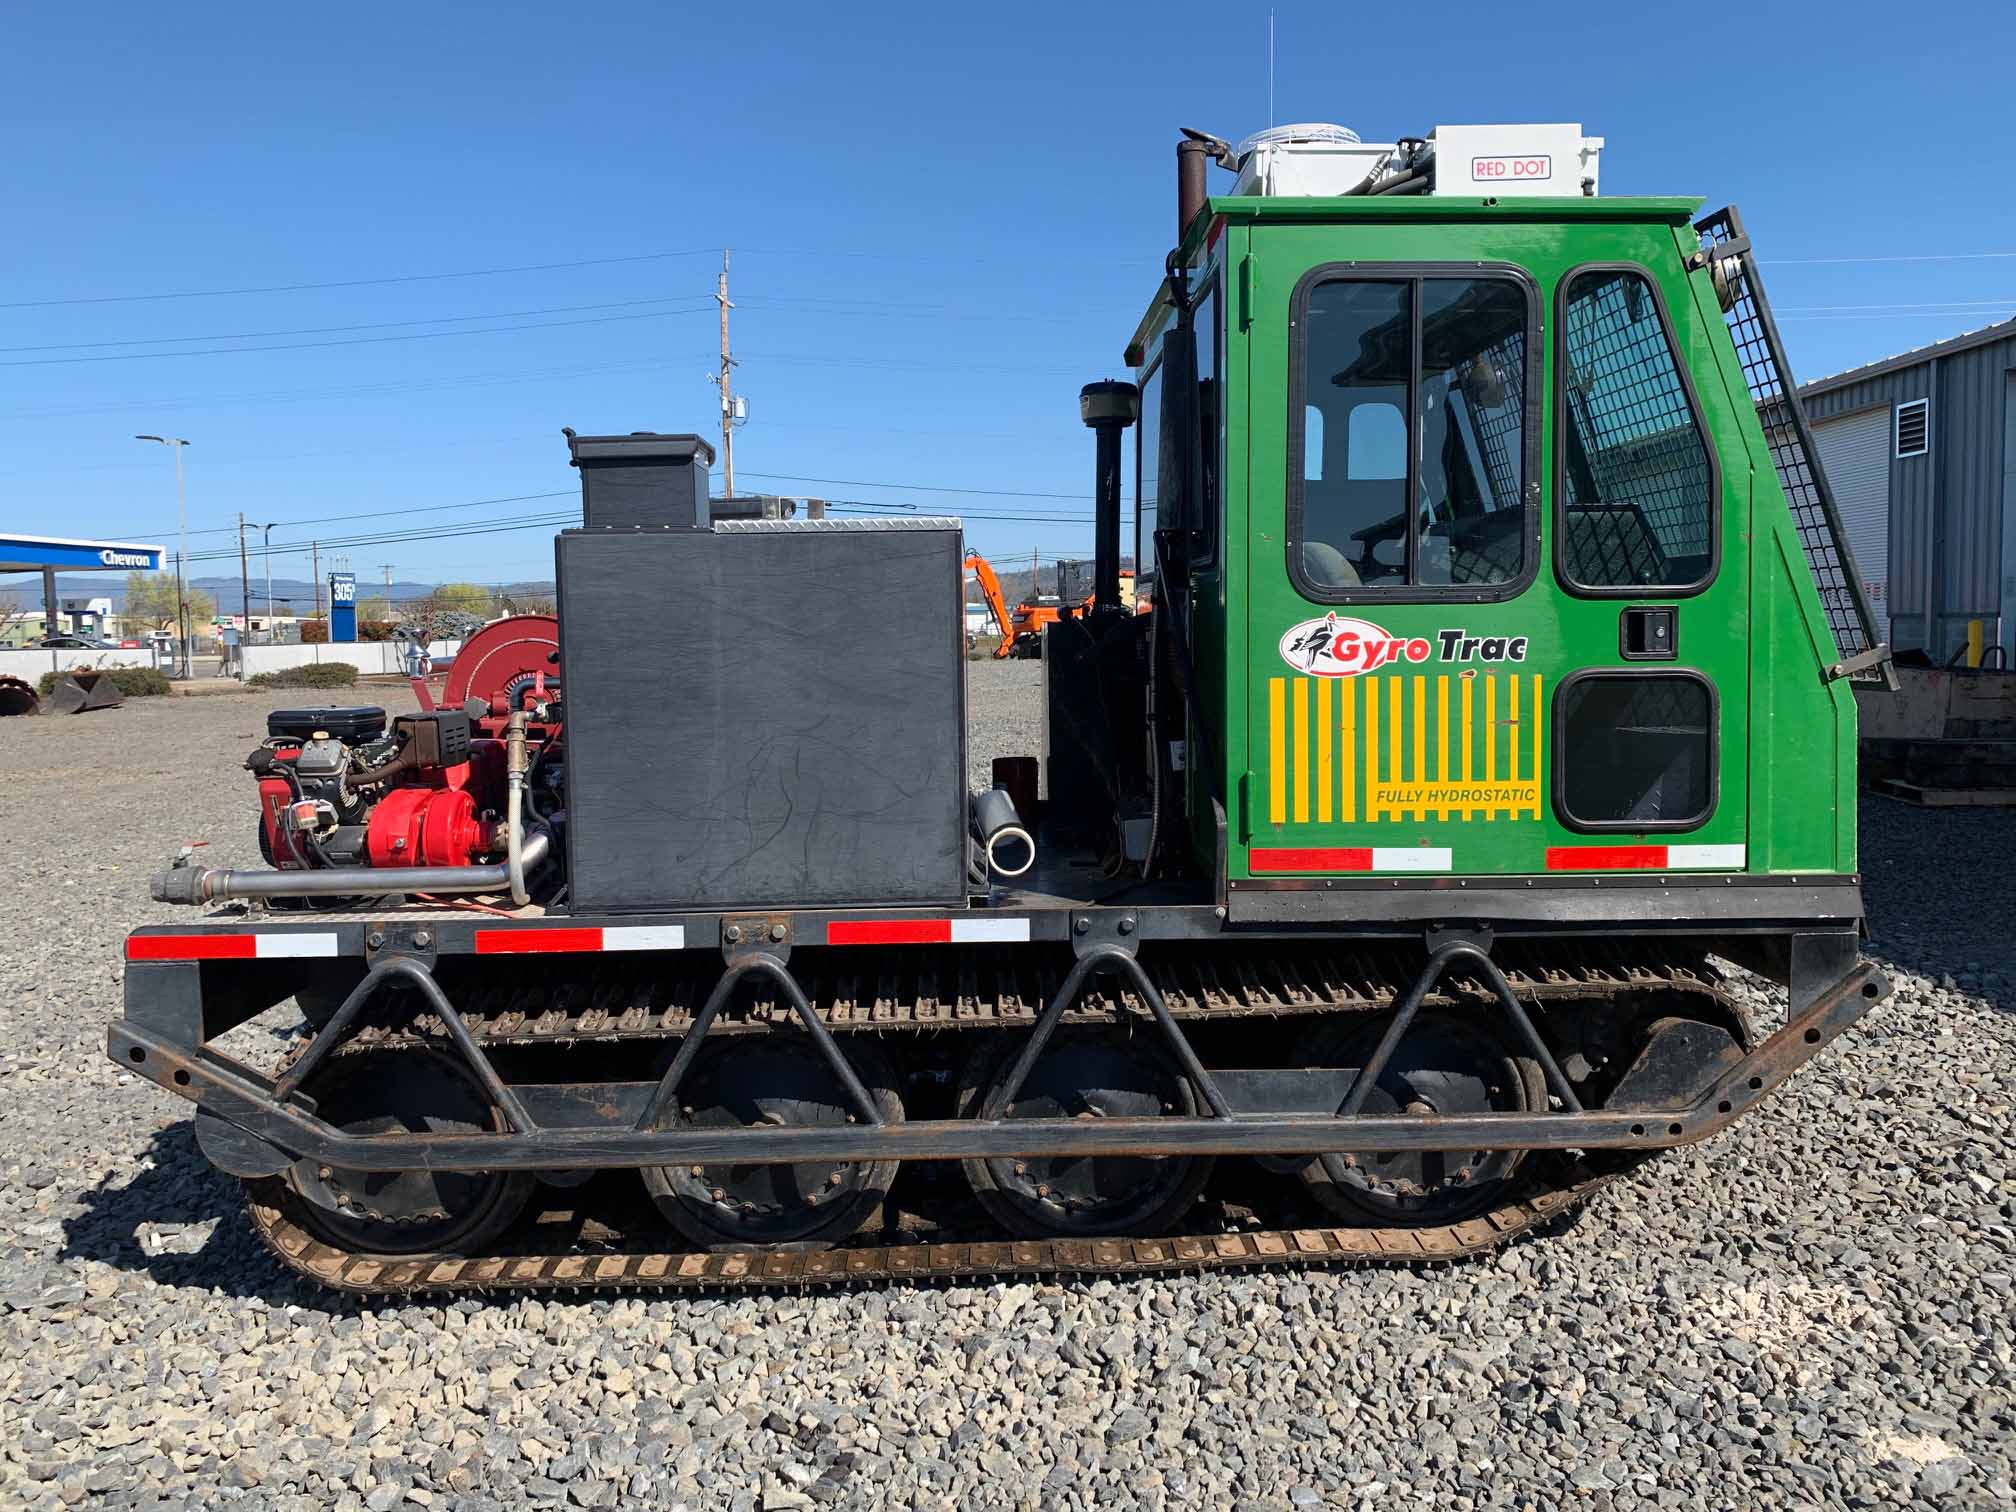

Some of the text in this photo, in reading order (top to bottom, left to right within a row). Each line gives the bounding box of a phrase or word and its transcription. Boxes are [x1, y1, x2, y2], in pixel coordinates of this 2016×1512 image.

[1476, 160, 1546, 176] RED DOT
[102, 549, 151, 567] Chevron
[1332, 629, 1527, 669] Gyro Trac
[1377, 788, 1535, 803] FULLY HYDROSTATIC
